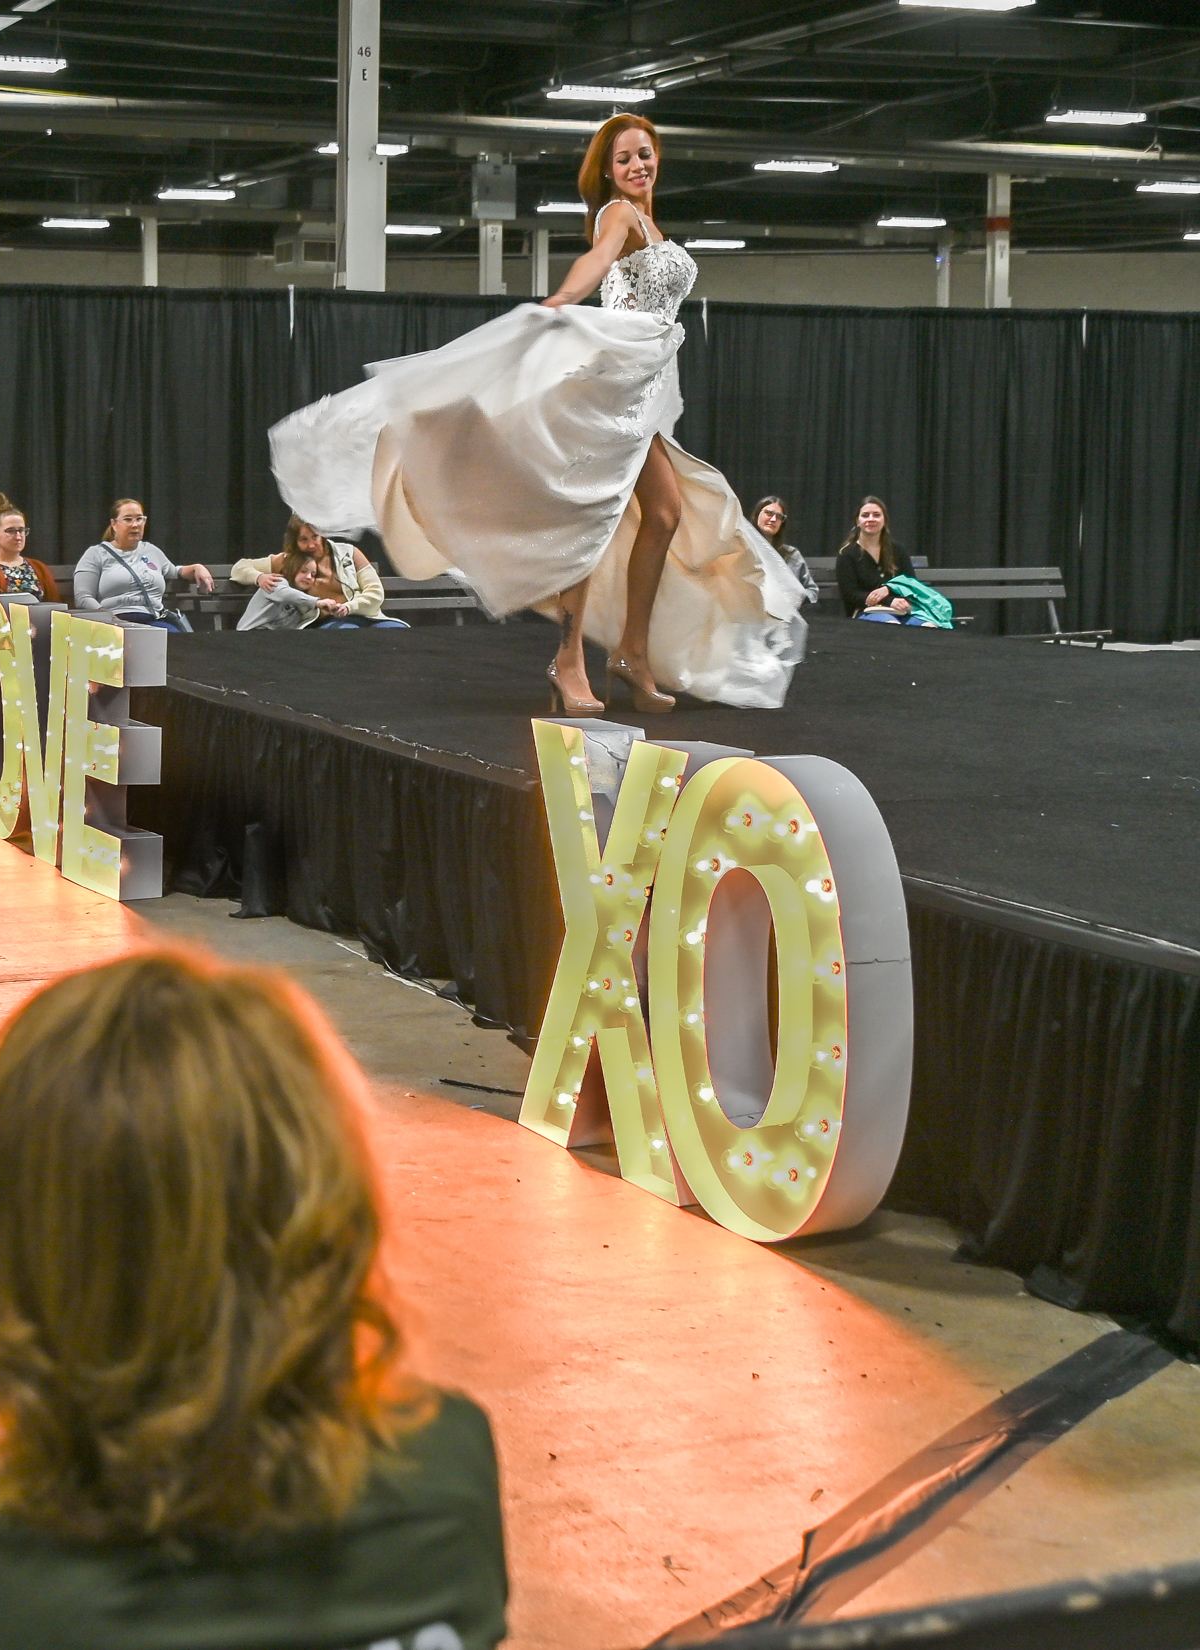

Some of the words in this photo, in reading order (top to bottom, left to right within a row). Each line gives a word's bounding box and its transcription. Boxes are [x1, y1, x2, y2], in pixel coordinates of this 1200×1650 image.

[357, 46, 372, 57] 46
[361, 68, 368, 81] E
[517, 718, 850, 1243] XO
